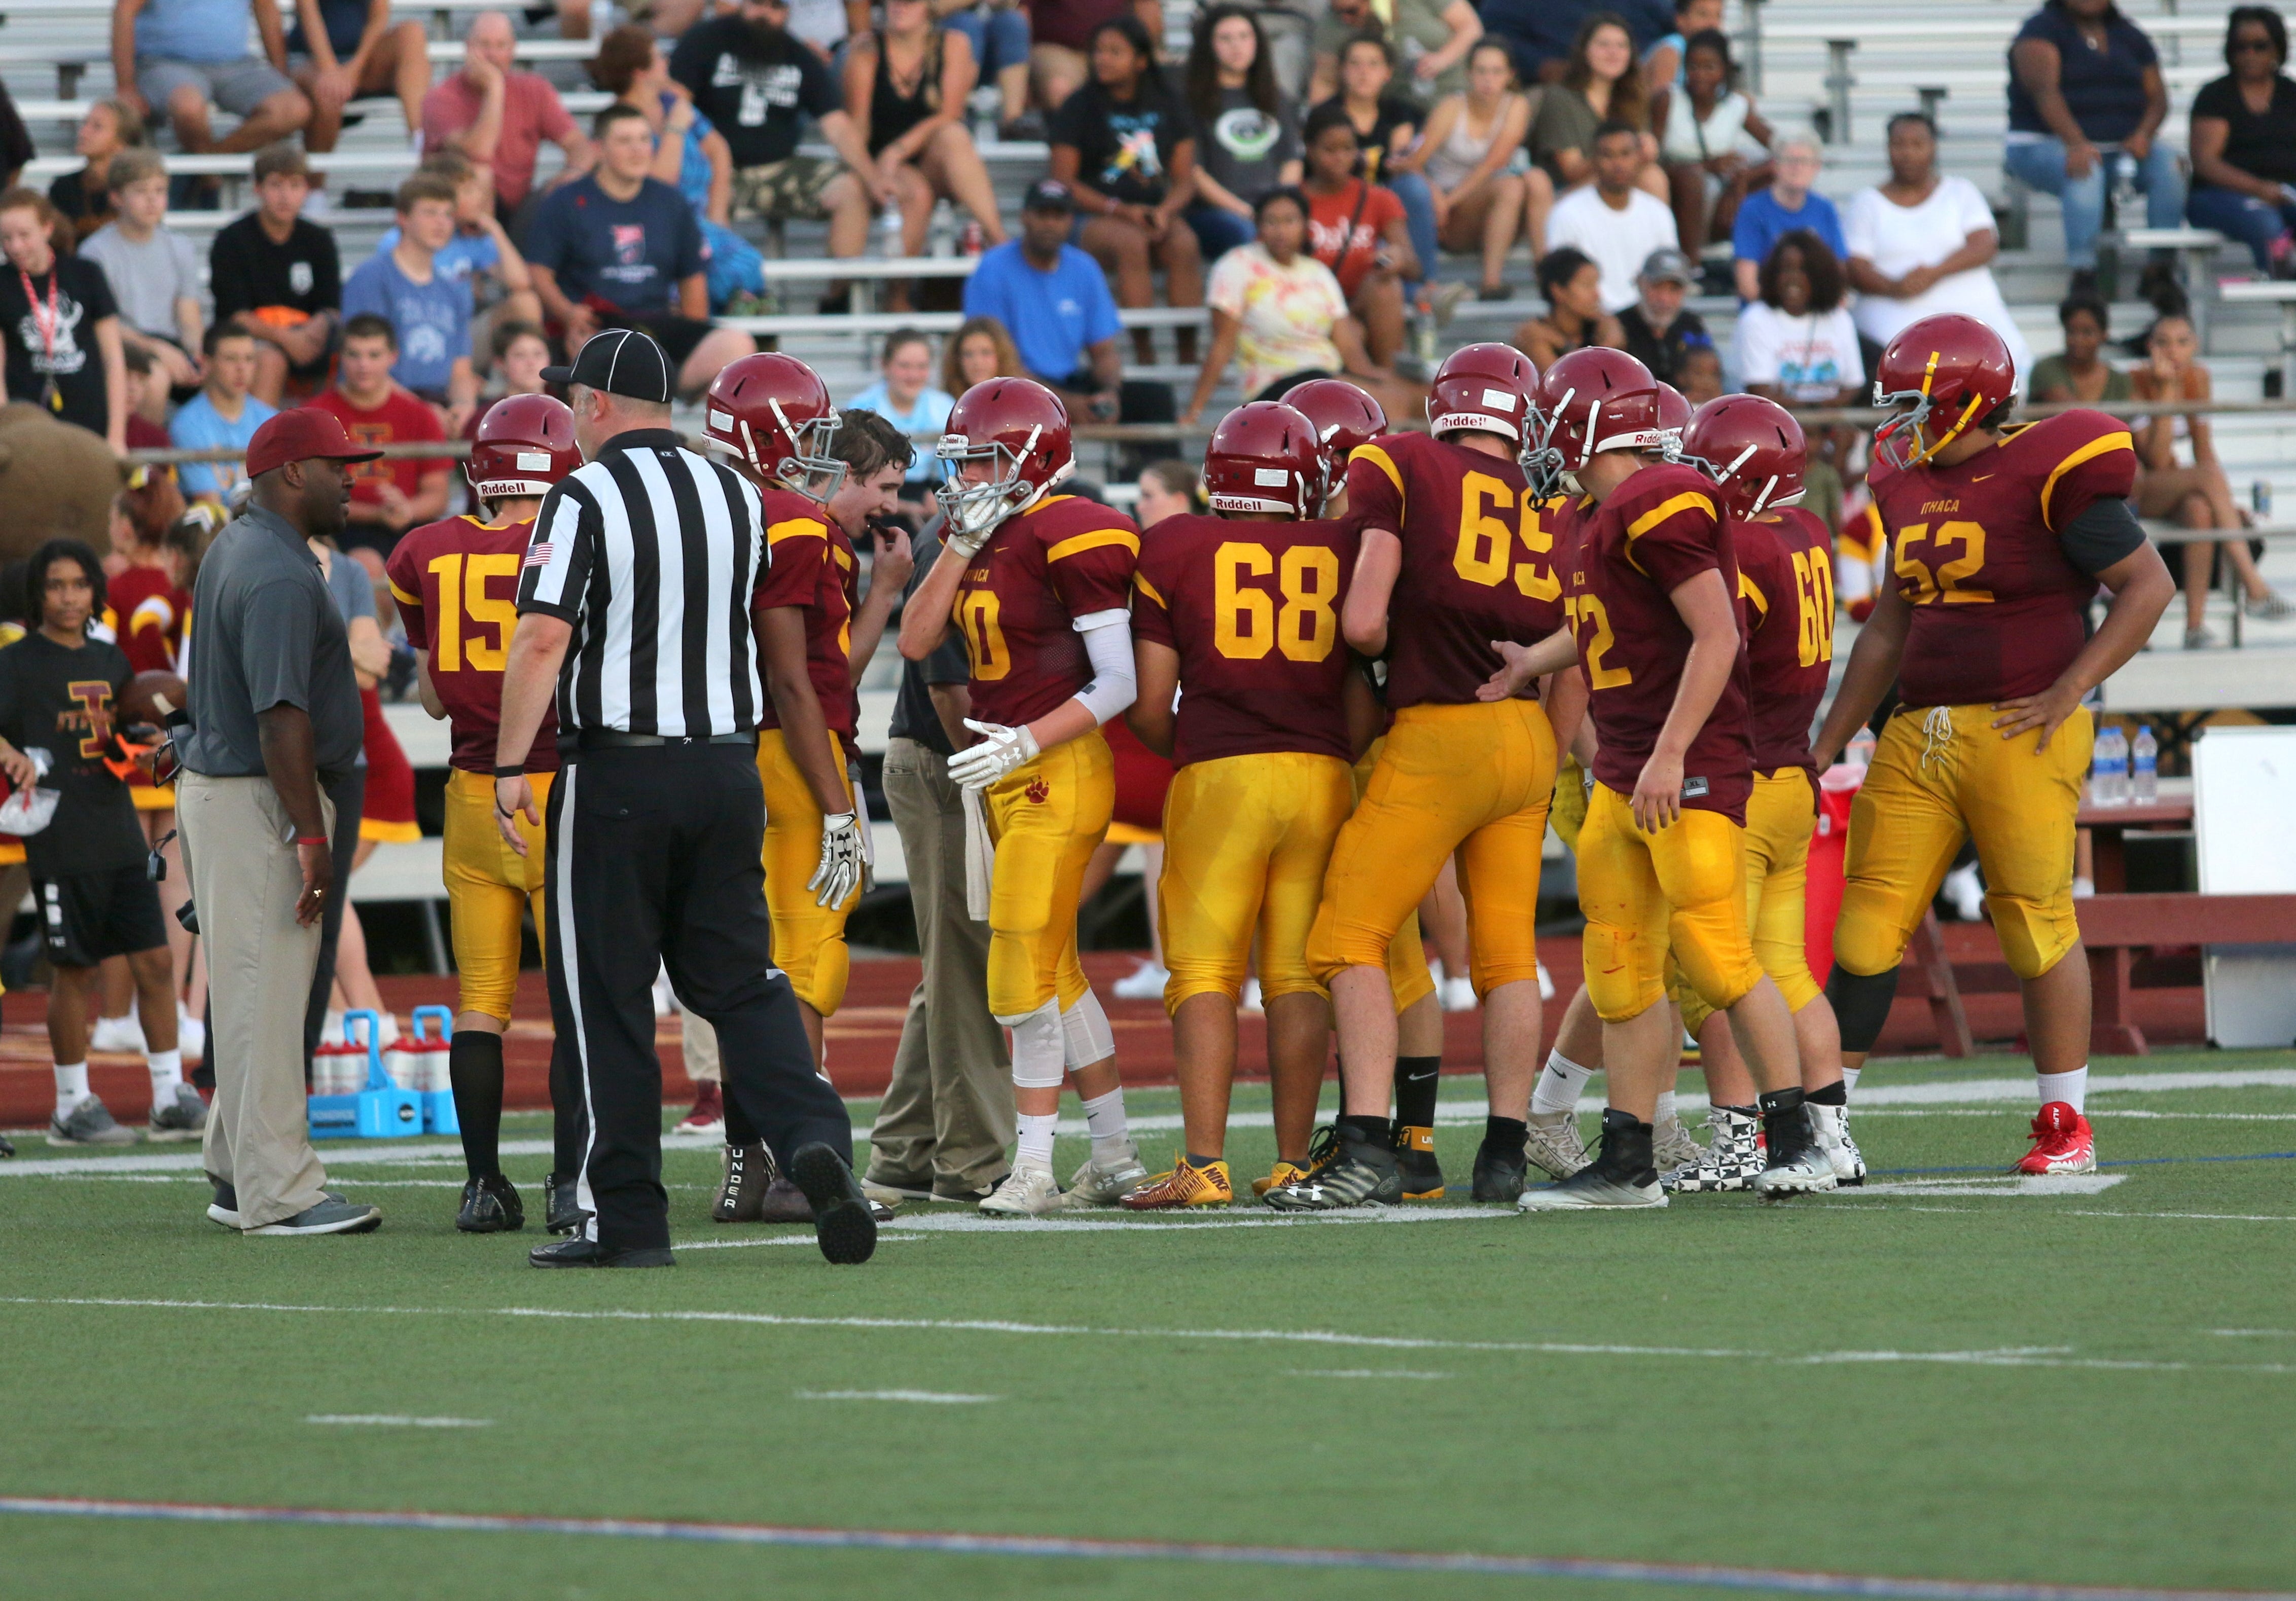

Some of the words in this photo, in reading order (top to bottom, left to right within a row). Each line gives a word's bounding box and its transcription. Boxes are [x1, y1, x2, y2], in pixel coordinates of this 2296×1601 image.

[1635, 434, 1660, 444] Ridde
[481, 483, 526, 495] Riddell
[1216, 498, 1262, 511] Riddell
[1920, 499, 1960, 515] ITHACA
[1452, 469, 1568, 603] 69
[1894, 520, 1995, 604] 52
[427, 554, 520, 672] 15
[953, 589, 1012, 681] 10
[1214, 541, 1339, 663] 68
[1563, 593, 1633, 690] 72
[1790, 545, 1835, 667] 60
[724, 1148, 744, 1209] UNDER
[1201, 1167, 1231, 1192] NIKE
